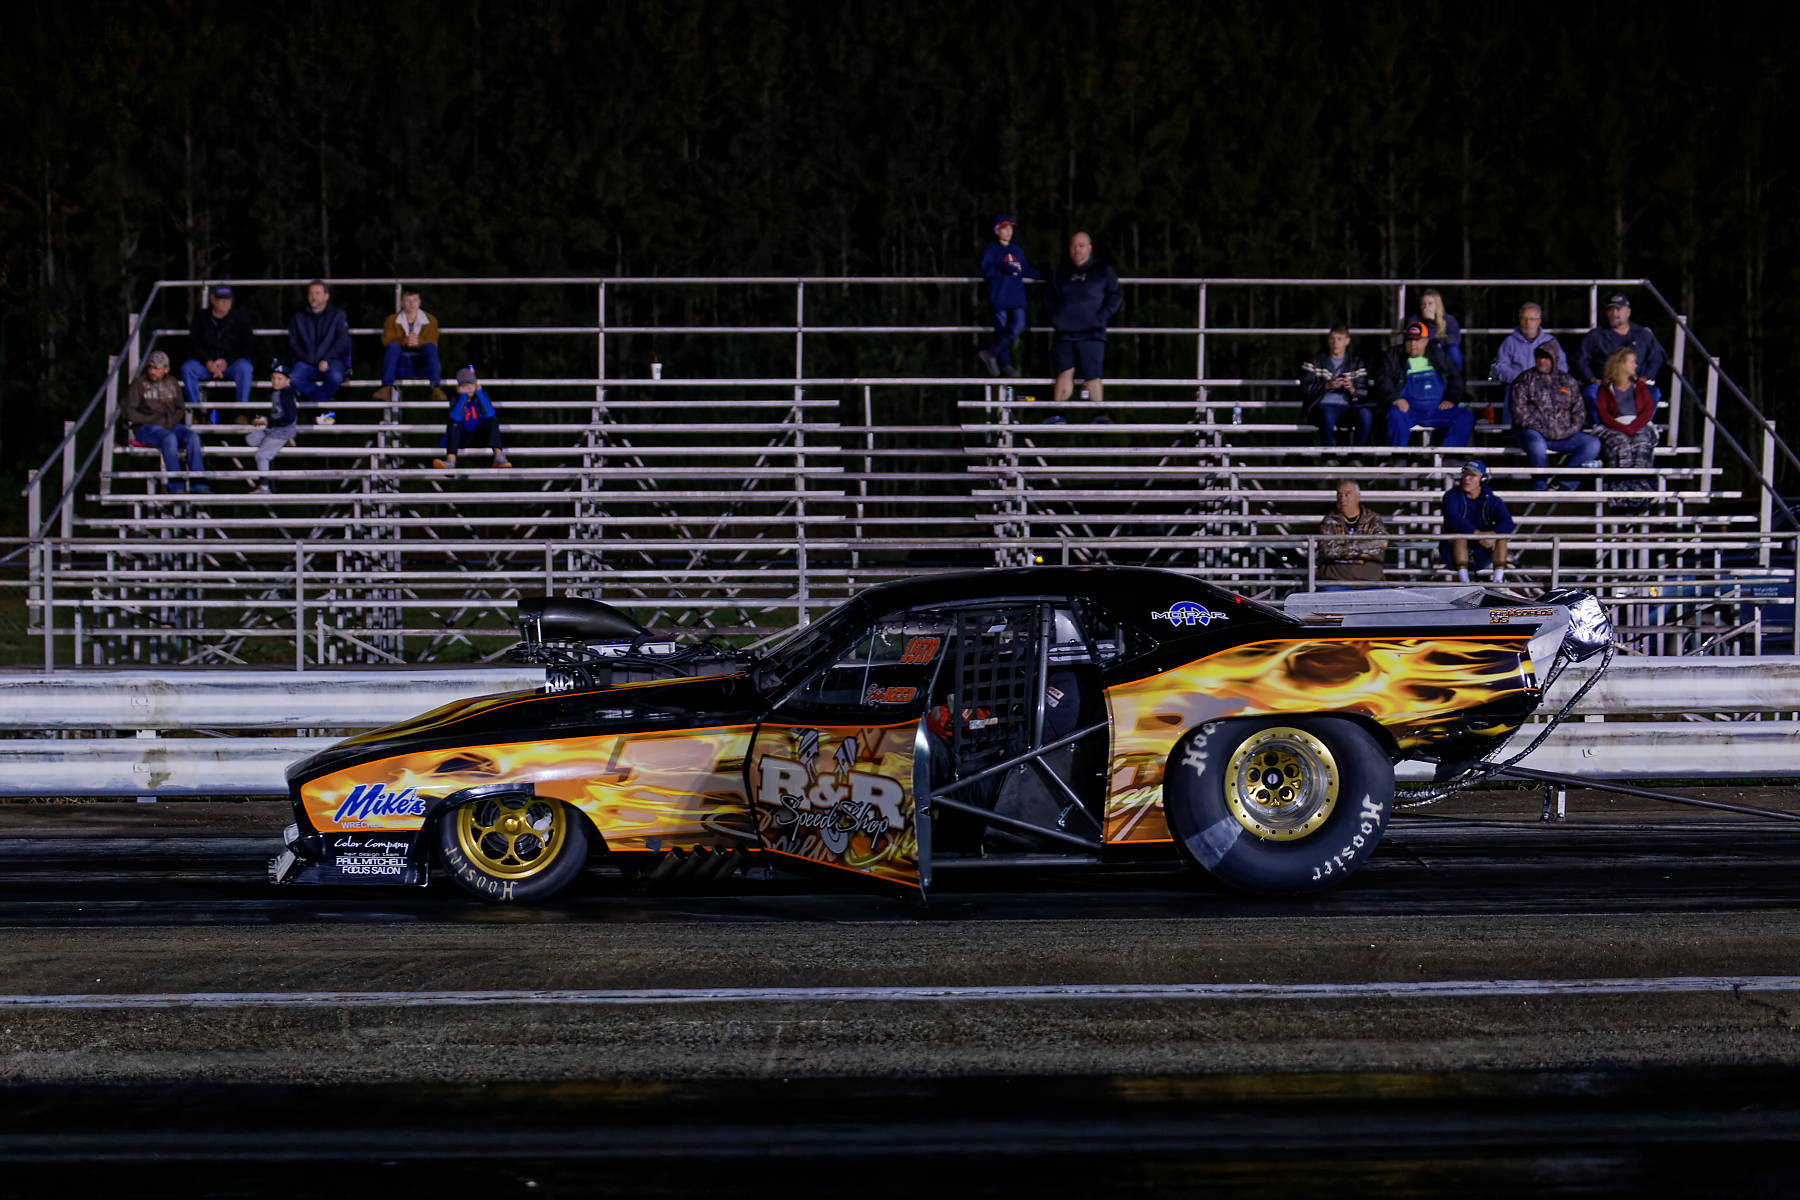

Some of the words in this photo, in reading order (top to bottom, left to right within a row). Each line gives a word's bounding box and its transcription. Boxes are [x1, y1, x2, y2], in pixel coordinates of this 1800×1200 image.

[1151, 611, 1230, 620] MOPAR
[332, 782, 426, 823] Mike's
[757, 754, 905, 830] R&R
[776, 795, 840, 842] Speed
[837, 801, 889, 849] Shop
[1312, 793, 1384, 880] Hoosier
[334, 836, 362, 848] Color
[364, 838, 409, 856] Company
[336, 857, 361, 865] PAUL
[361, 857, 406, 865] MITCHELL
[342, 866, 370, 874] FOCUS
[371, 866, 401, 875] SALON
